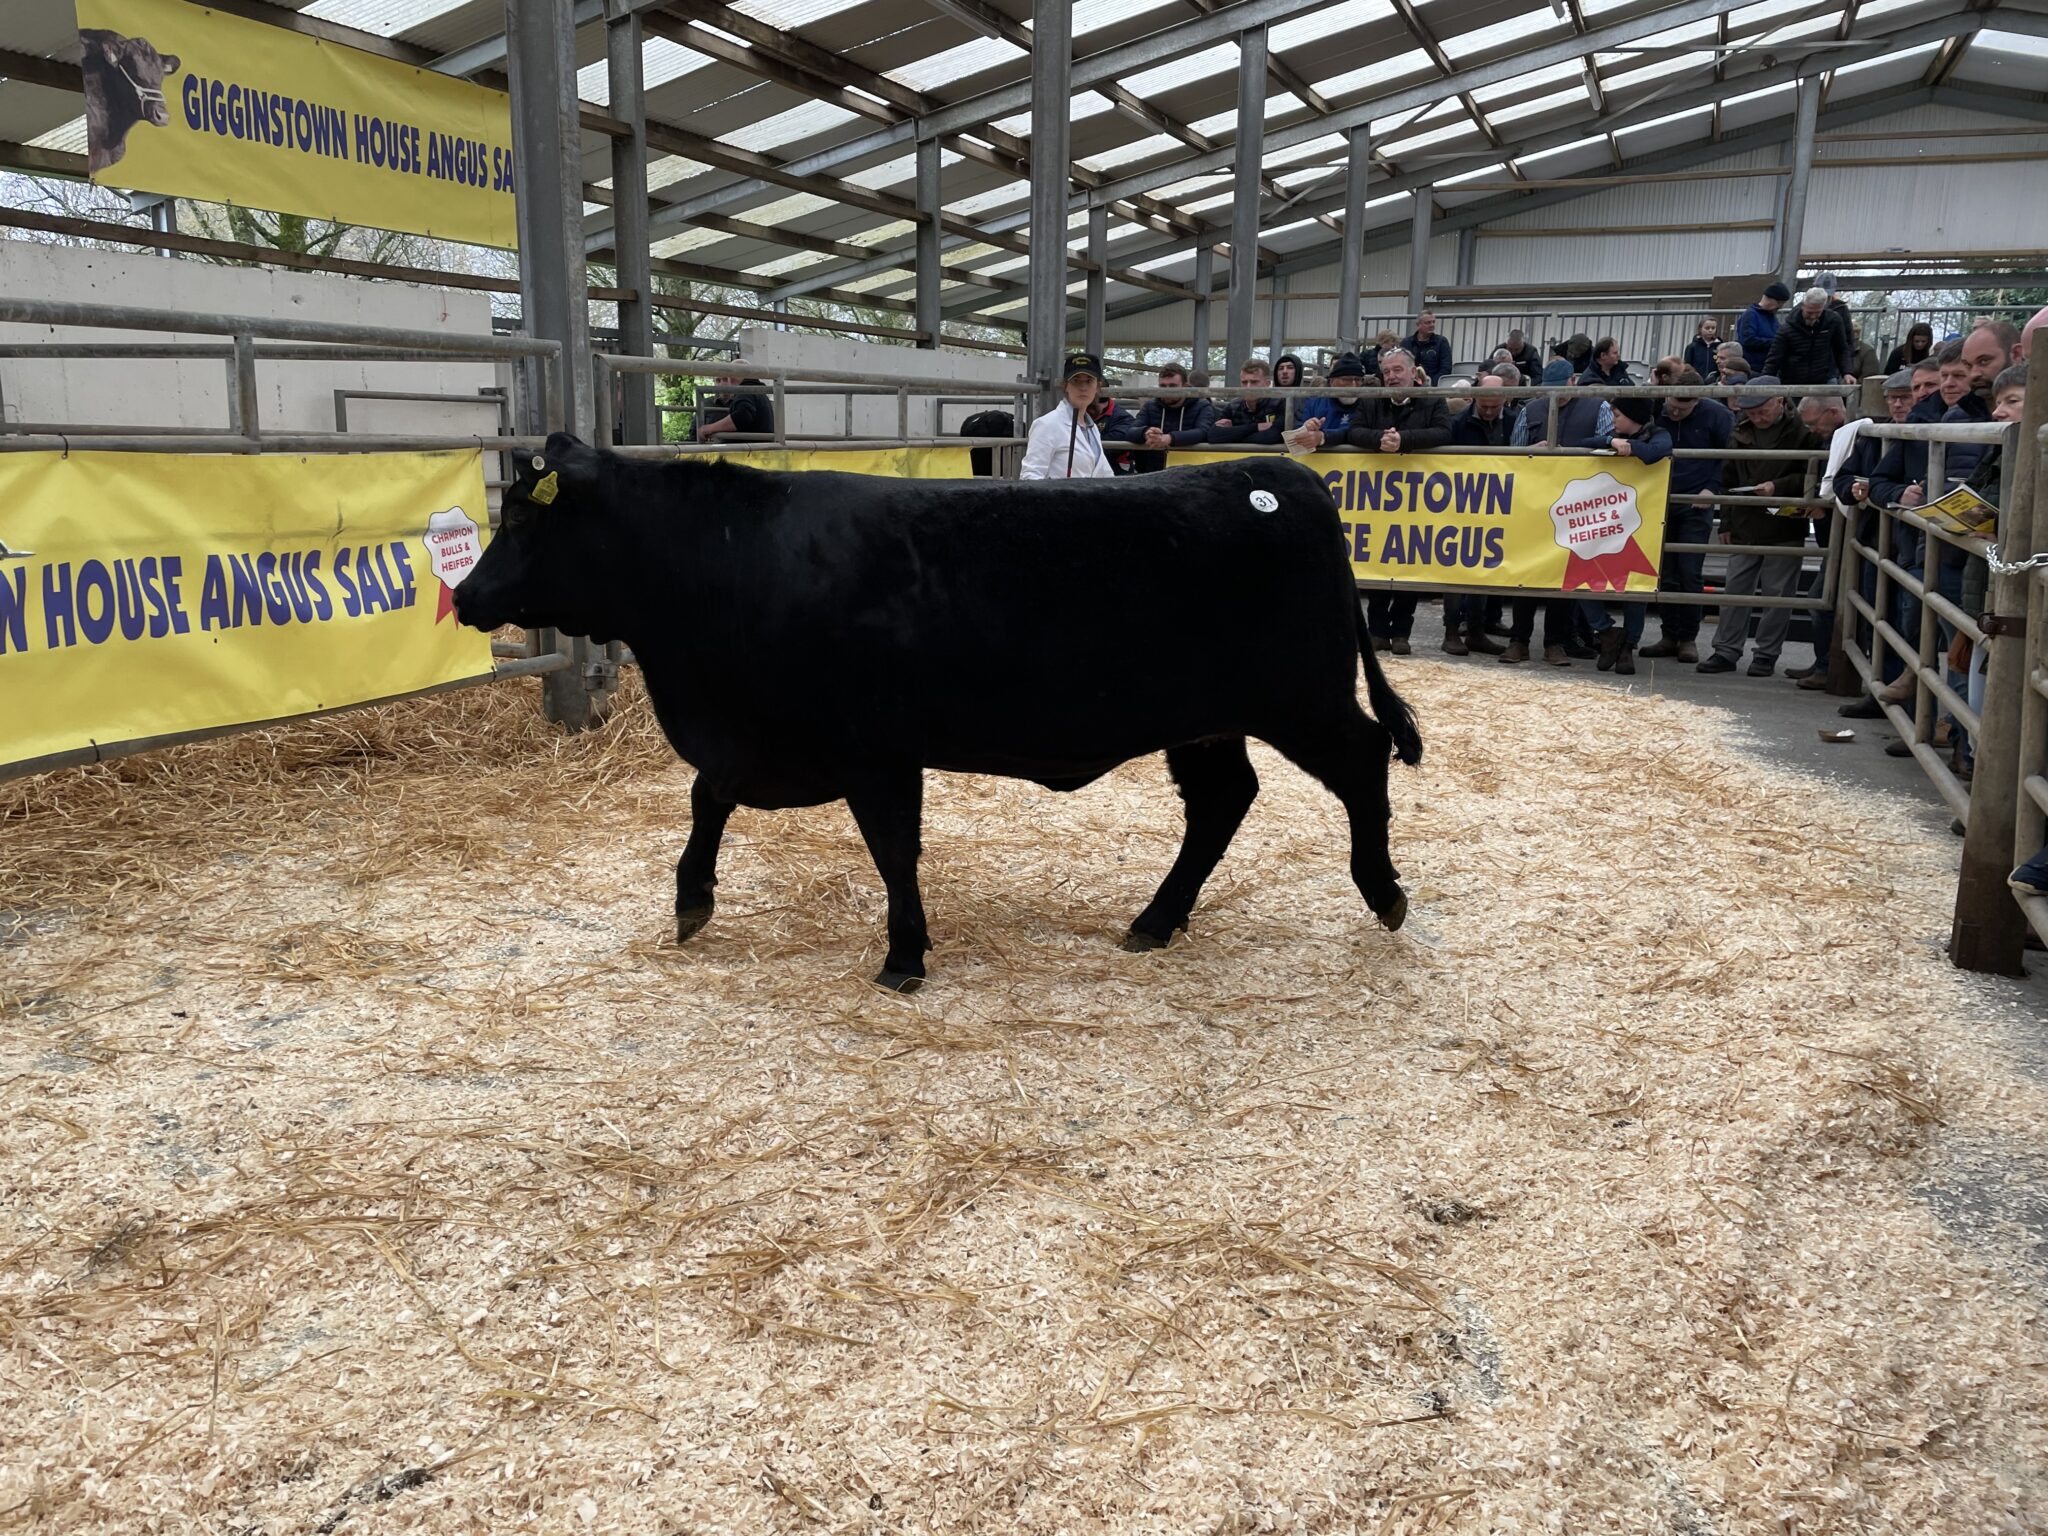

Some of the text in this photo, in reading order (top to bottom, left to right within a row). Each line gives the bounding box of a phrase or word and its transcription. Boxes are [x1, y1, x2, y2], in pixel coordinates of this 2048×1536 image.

[182, 73, 515, 193] GIGGINSTOWN HOUSE ANGUS SA
[1255, 495, 1274, 508] 31
[1556, 491, 1628, 516] CHAMPION
[1568, 509, 1620, 529] BULLS &
[431, 526, 473, 544] CHAMPION
[1569, 523, 1624, 544] HEIFERS
[441, 542, 471, 557] BULLS &
[1380, 524, 1504, 568] ANGUS
[441, 555, 474, 572] HEIFERS
[42, 556, 191, 650] HOUSE
[201, 549, 332, 631] ANGUS
[333, 541, 416, 617] SALE
